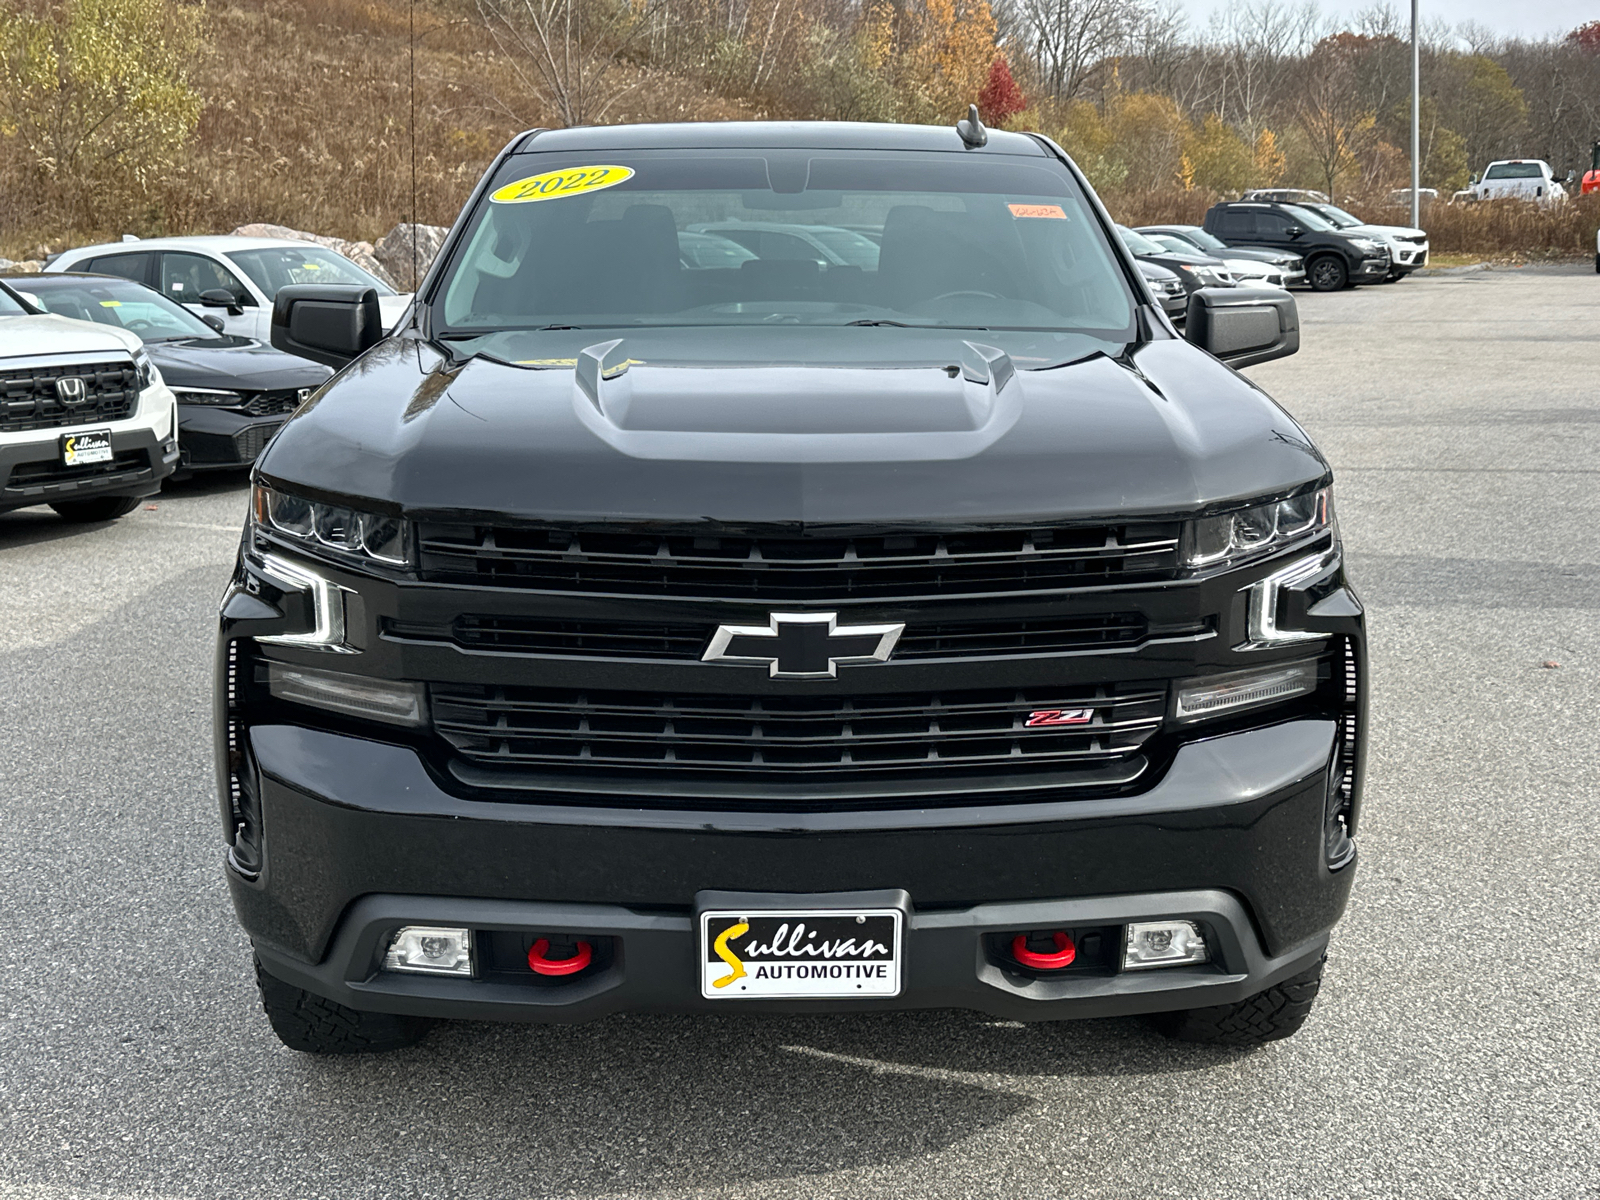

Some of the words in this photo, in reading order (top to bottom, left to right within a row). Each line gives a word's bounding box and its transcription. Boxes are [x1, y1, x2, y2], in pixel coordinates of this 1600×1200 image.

[514, 169, 610, 199] 2022
[65, 436, 109, 461] Sullivan
[77, 449, 109, 457] AUTOMOTIVE
[1025, 708, 1095, 727] Z71
[712, 922, 889, 989] Sullivan
[755, 964, 888, 980] AUTOMOTIVE
